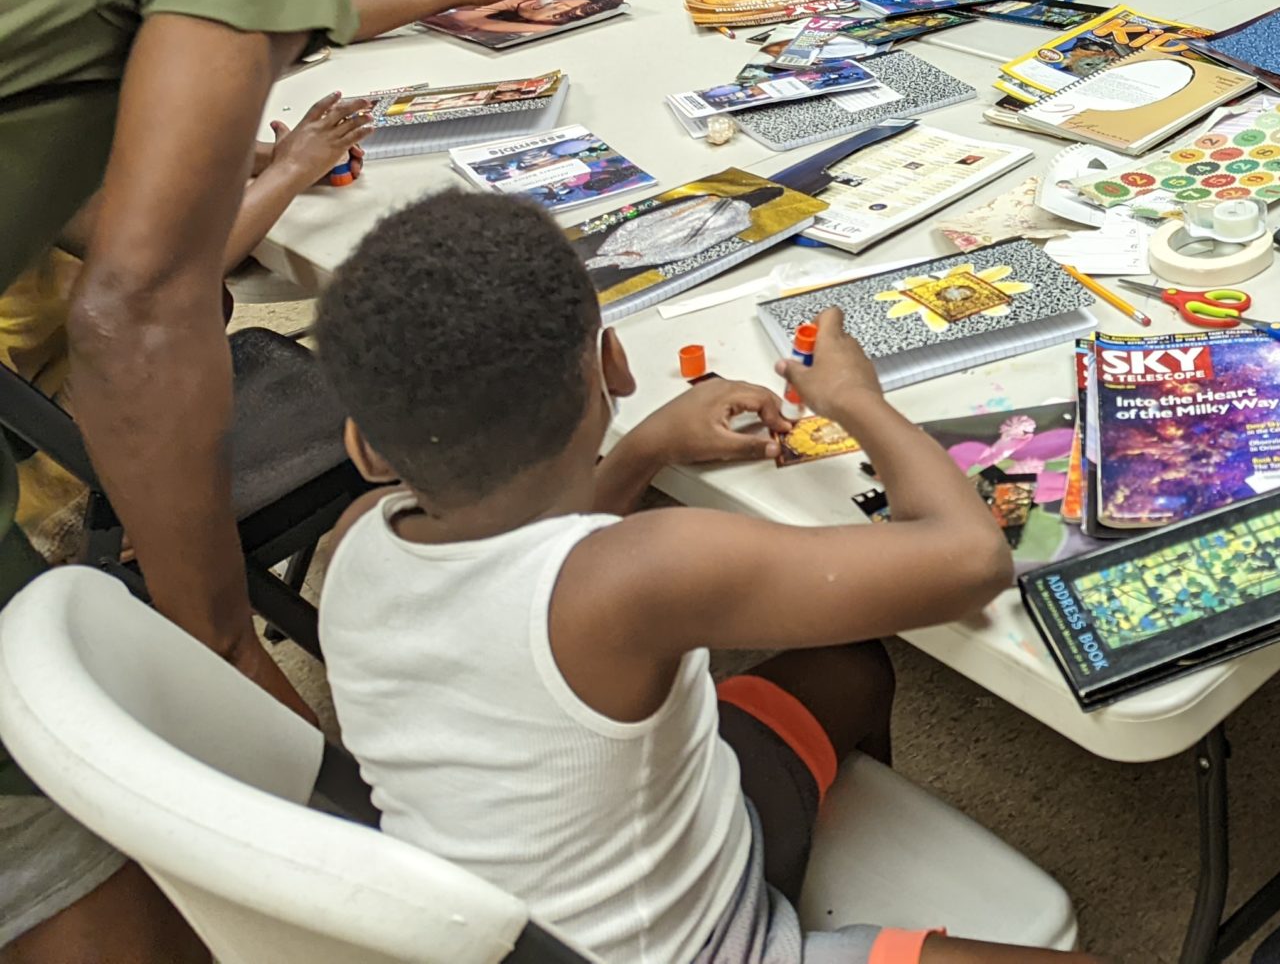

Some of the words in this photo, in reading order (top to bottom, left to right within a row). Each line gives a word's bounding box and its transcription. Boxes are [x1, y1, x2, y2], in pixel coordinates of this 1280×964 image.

[487, 134, 566, 157] assemble
[1202, 138, 1220, 146] 2
[1256, 148, 1274, 156] 8
[1129, 175, 1147, 185] 2
[1101, 347, 1204, 376] SKY
[1116, 370, 1205, 383] TELESCOPE
[1116, 395, 1159, 408] Into
[1162, 393, 1193, 405] the
[1197, 388, 1257, 403] Heart
[1115, 409, 1138, 420] of
[1139, 407, 1175, 420] the
[1177, 401, 1229, 418] Milky
[1046, 575, 1086, 630] ADDRESS
[1078, 631, 1109, 671] BOOK
